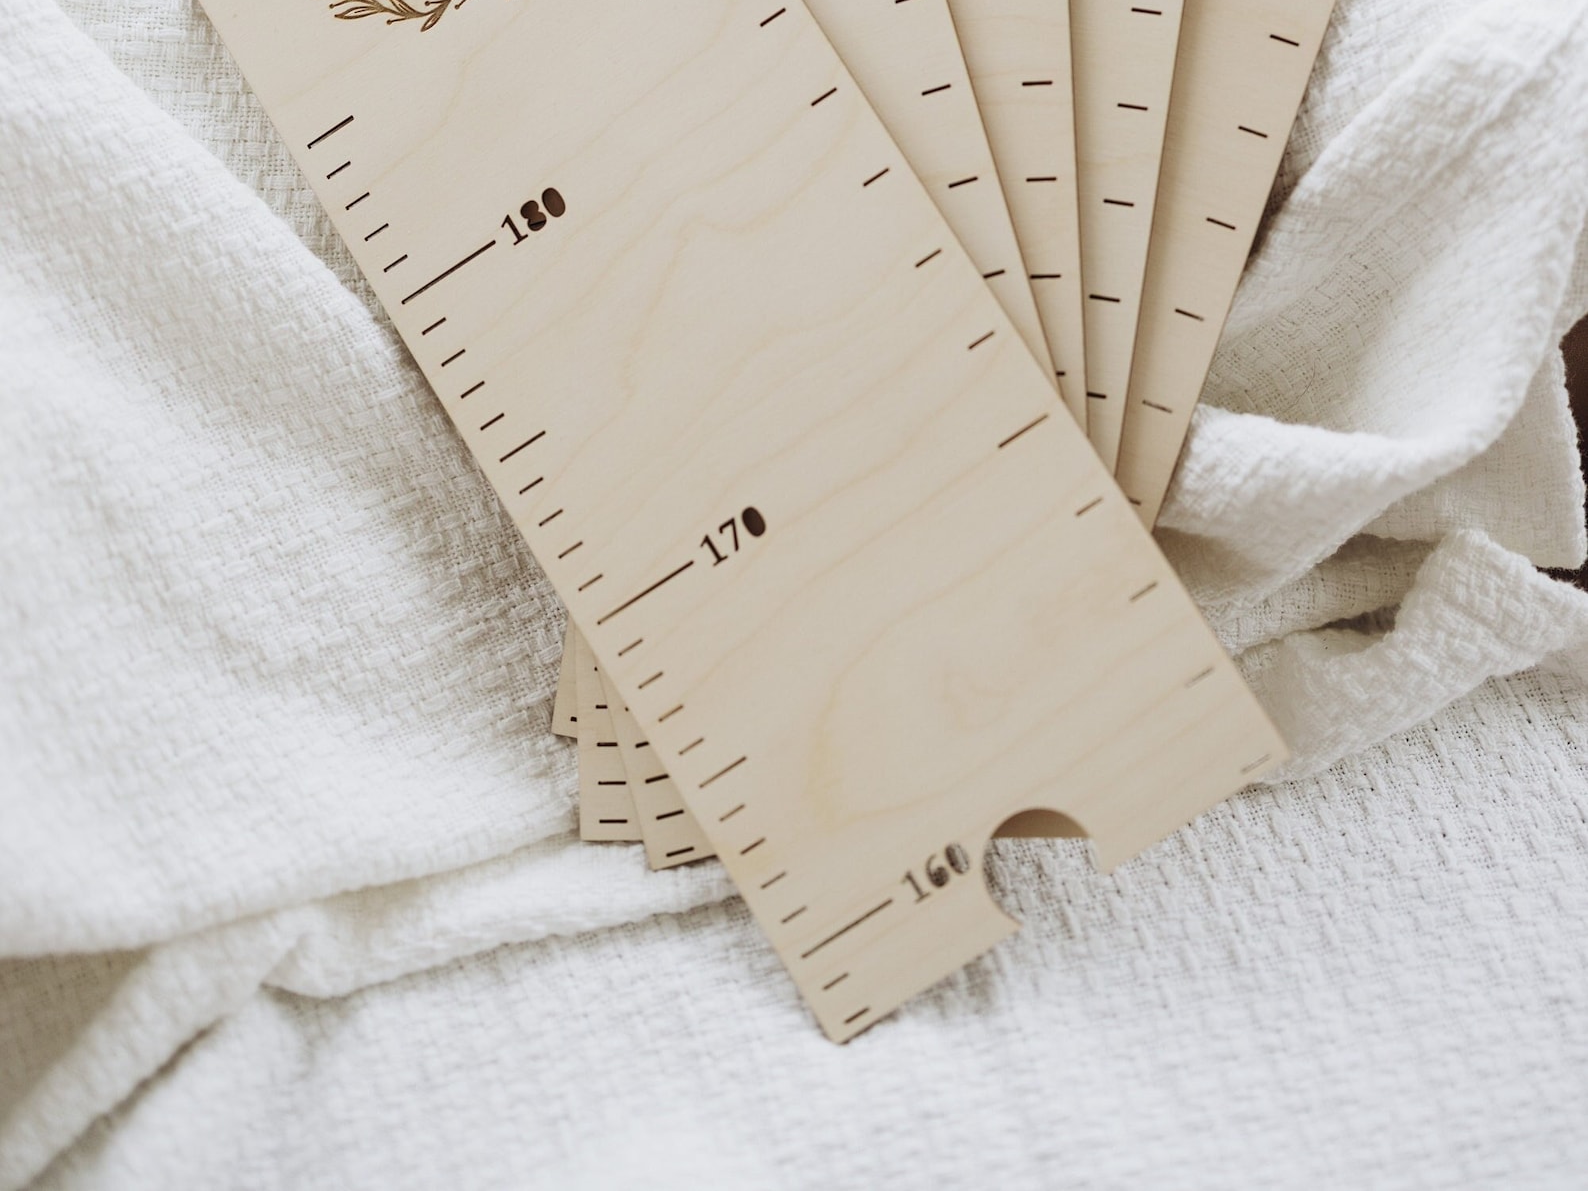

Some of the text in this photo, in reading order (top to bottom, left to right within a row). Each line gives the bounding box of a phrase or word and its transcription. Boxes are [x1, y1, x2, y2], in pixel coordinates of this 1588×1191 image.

[500, 187, 566, 246] 180
[700, 506, 767, 567] 170
[901, 842, 970, 903] 160
